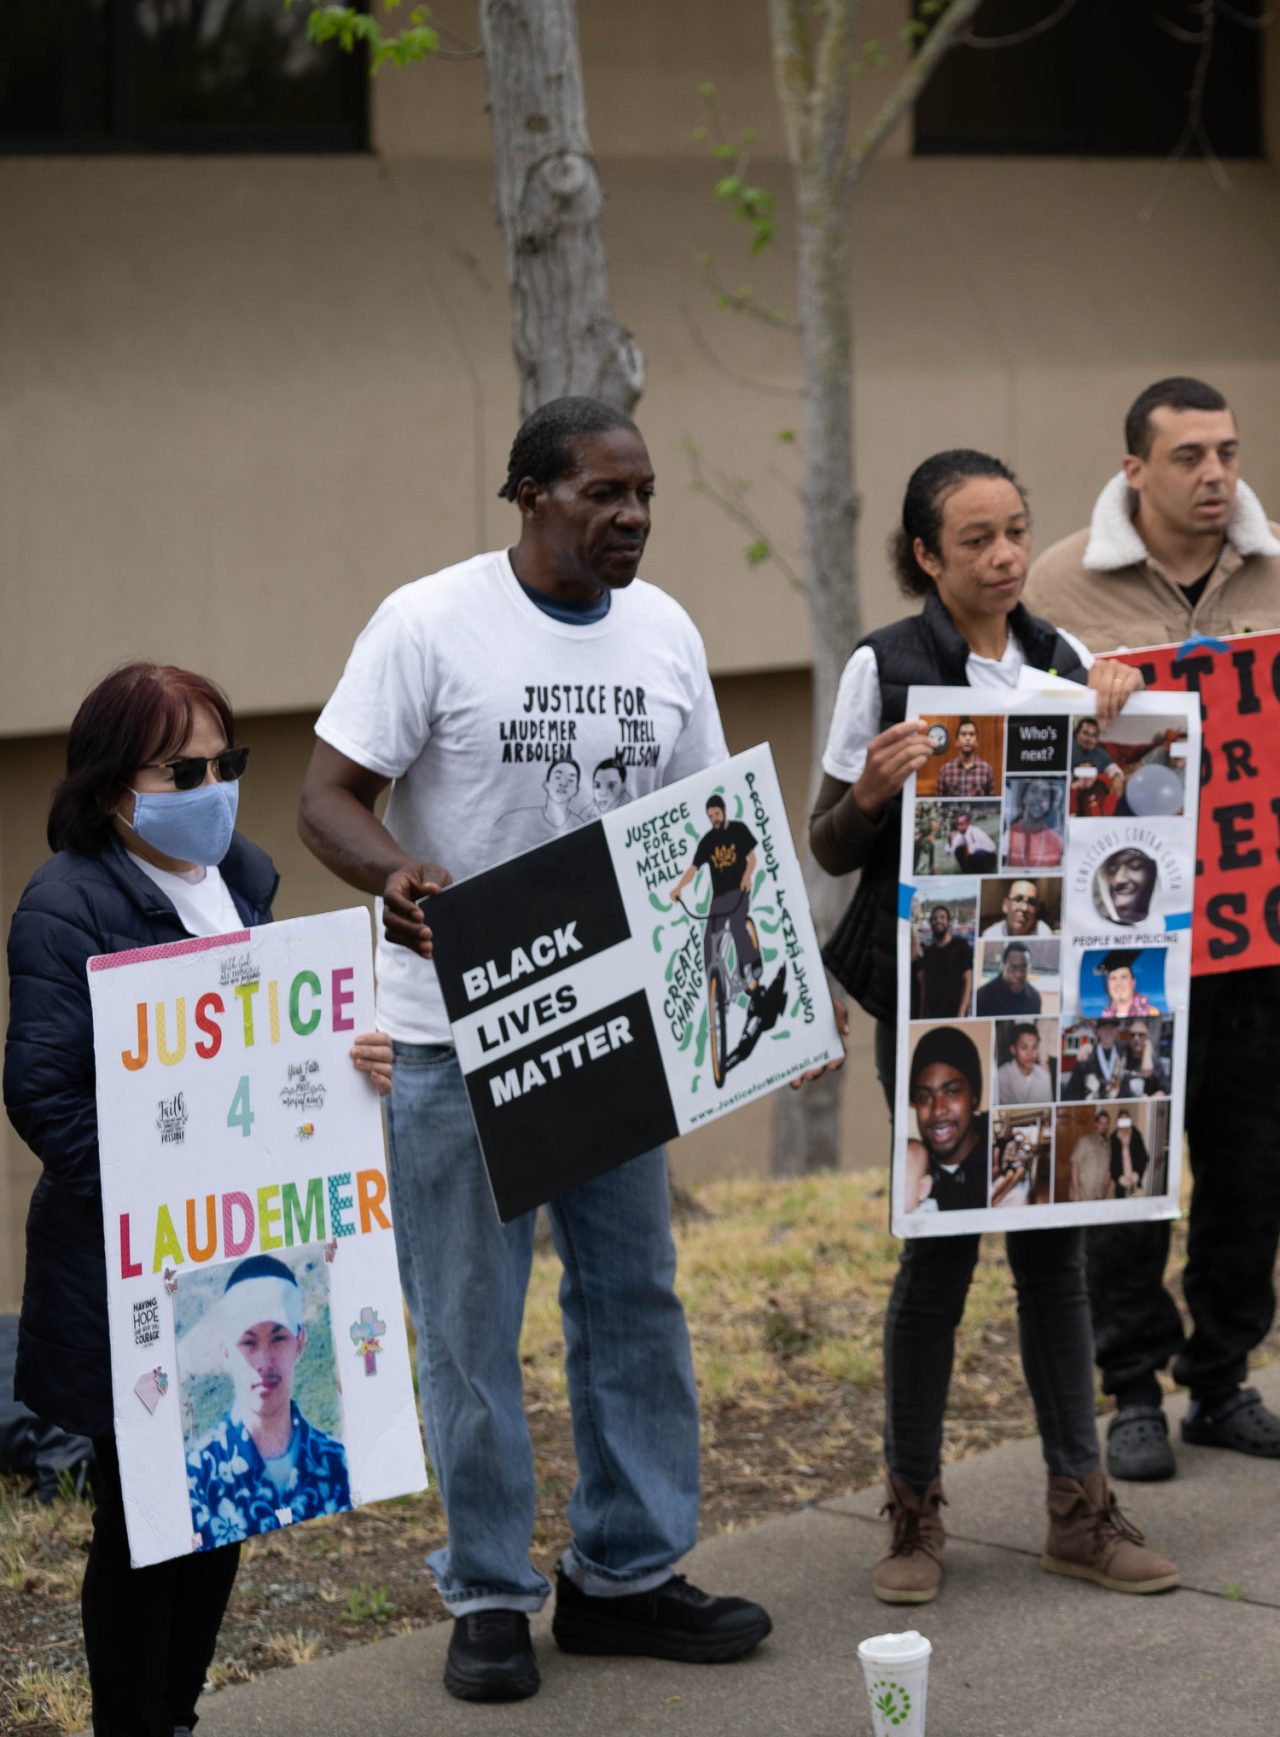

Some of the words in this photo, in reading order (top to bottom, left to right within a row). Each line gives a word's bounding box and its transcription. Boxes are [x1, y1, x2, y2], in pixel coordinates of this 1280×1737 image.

[523, 685, 606, 714] JUSTICE
[614, 686, 647, 716] FOR
[500, 720, 577, 742] LAUDEMER
[618, 718, 656, 743] TYRELL
[1019, 725, 1058, 741] Who's
[502, 742, 574, 763] ARBOLEDA
[614, 745, 661, 767] WILSON
[1021, 746, 1055, 762] next?
[625, 802, 690, 848] JUSTICE
[643, 830, 672, 853] FOR
[745, 772, 780, 882] PROTECT
[636, 839, 688, 877] MILES
[645, 864, 684, 891] HALL
[1072, 935, 1109, 947] PEOPLE
[1114, 934, 1131, 945] NOT
[461, 920, 583, 1001] BLACK
[664, 925, 701, 1019] CREATE
[671, 951, 704, 1042] CHANGE
[121, 967, 355, 1072] JUSTICE
[477, 984, 578, 1053] LIVES
[489, 1015, 634, 1107] MATTER
[227, 1075, 255, 1137] 4
[119, 1169, 393, 1279] LAUDEMER
[133, 1306, 159, 1329] HOPE
